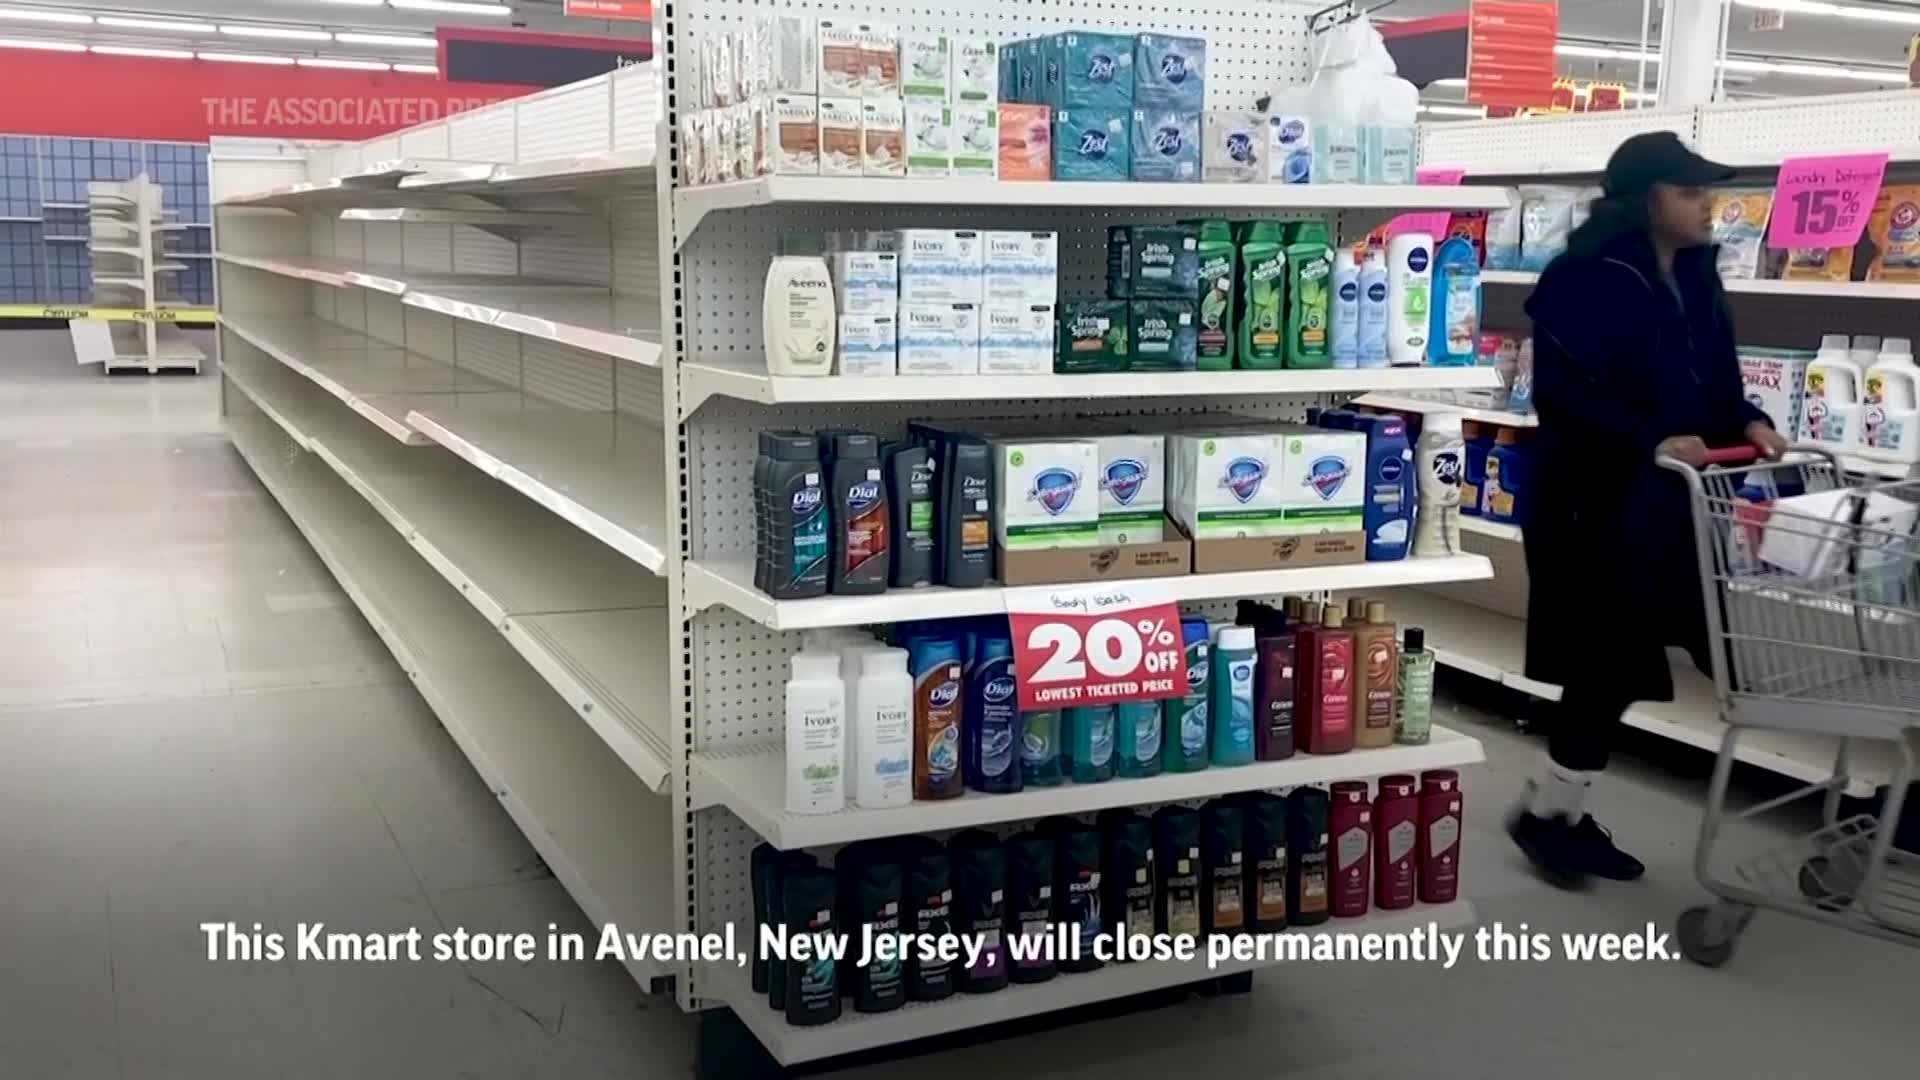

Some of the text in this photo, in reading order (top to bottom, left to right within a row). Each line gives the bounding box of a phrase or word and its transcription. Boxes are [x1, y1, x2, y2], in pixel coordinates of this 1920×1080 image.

[1088, 55, 1115, 79] Zest
[1160, 55, 1187, 77] Zest
[1080, 134, 1109, 154] Zest
[1154, 131, 1181, 150] Zest
[1792, 190, 1860, 234] 15%
[1837, 215, 1856, 227] OFF
[912, 239, 944, 251] IVORY
[1146, 243, 1170, 255] Irish
[1141, 252, 1174, 265] Spring
[787, 279, 827, 288] Aveeno
[910, 311, 943, 323] IVORY
[1144, 318, 1168, 330] Irish
[1071, 324, 1104, 338] Spring
[1138, 326, 1173, 341] Spring
[1742, 374, 1781, 391] ORAX
[1432, 455, 1460, 478] Zest
[793, 491, 822, 505] Dial
[849, 486, 878, 500] Dial
[1027, 618, 1175, 684] 20%
[1145, 651, 1179, 674] OFF
[930, 686, 958, 702] Dial
[1036, 679, 1174, 702] LOWEST TICKETED PRICE
[804, 714, 837, 727] IVORY
